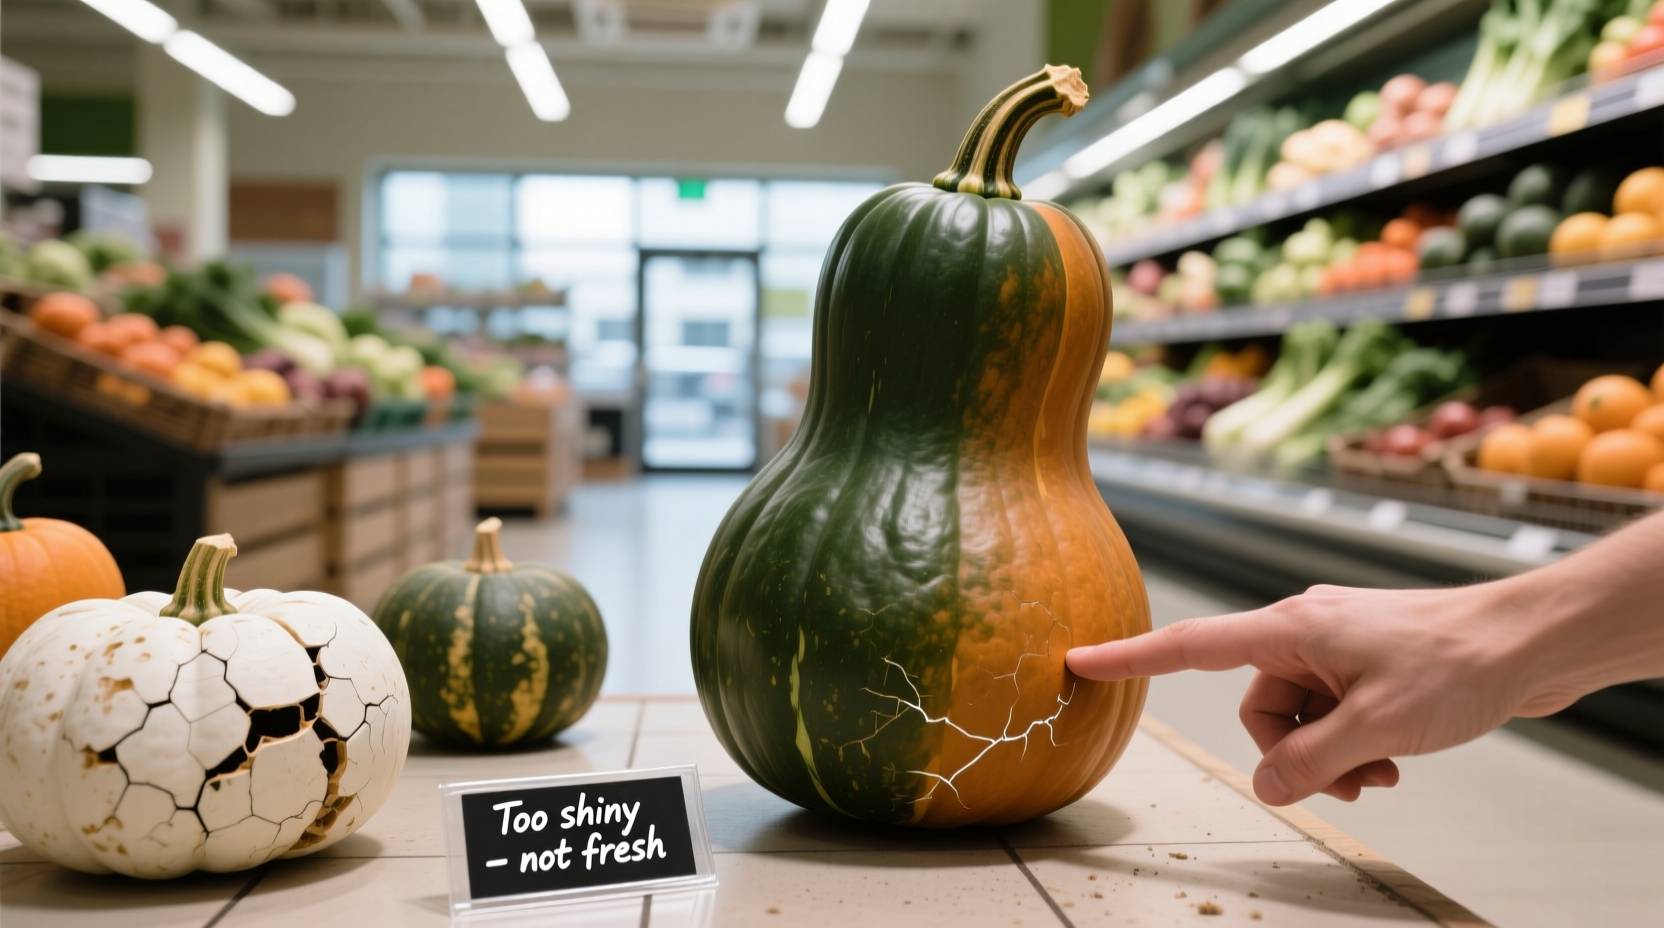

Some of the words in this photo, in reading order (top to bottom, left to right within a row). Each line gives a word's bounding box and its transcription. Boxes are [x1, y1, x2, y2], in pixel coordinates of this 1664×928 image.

[492, 800, 548, 836] Too
[560, 792, 641, 837] shiny
[519, 838, 573, 873] not
[581, 823, 667, 871] fresh
